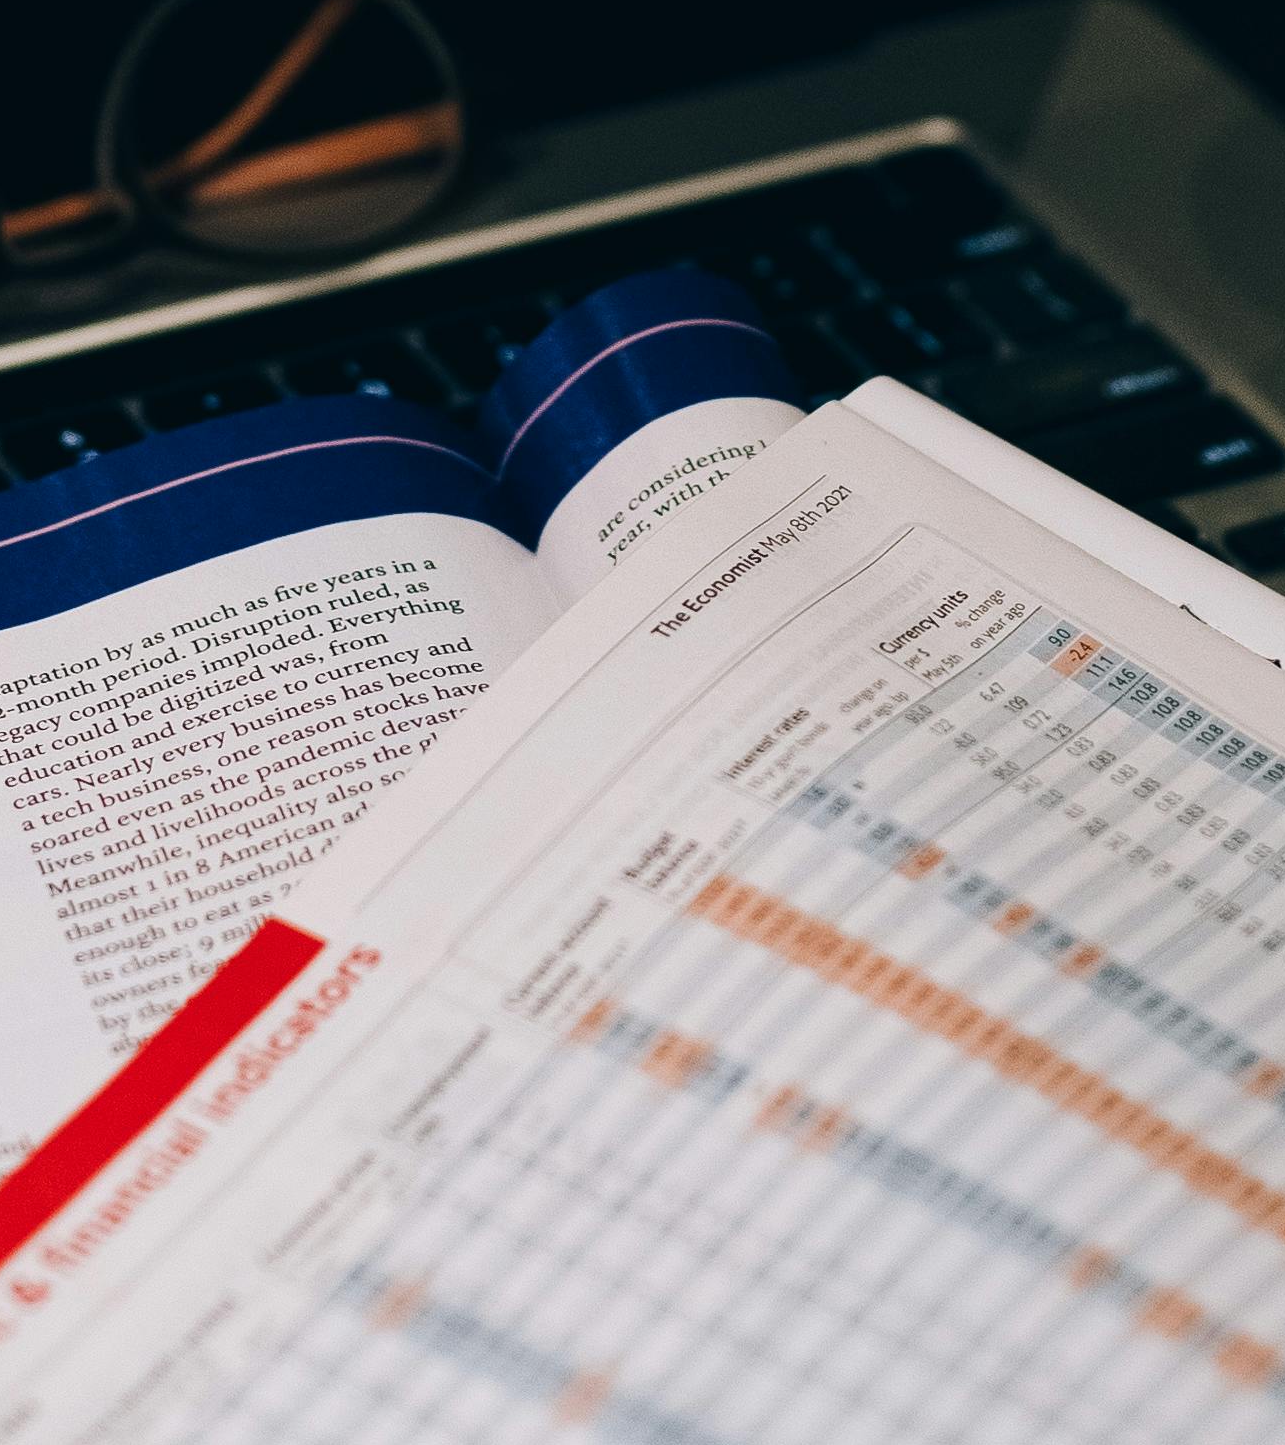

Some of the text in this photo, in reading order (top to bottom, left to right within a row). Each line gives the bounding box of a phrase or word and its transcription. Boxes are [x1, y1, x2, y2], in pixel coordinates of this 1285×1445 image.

[597, 444, 757, 543] are considering
[606, 484, 704, 566] year, with
[650, 484, 853, 638] The Economist May 8th 2021
[102, 647, 188, 692] period.
[191, 601, 323, 654] Disruption
[328, 583, 401, 611] ruled,
[405, 580, 430, 594] as
[104, 641, 134, 662] by
[142, 632, 165, 650] as
[171, 604, 239, 638] much
[244, 595, 269, 612] as
[274, 580, 319, 603] five
[323, 564, 387, 592] years
[392, 560, 417, 575] in
[423, 559, 437, 571] a
[878, 589, 969, 655] Currency units
[968, 588, 1006, 623] change
[969, 602, 1026, 651] on year ago
[1047, 627, 1071, 649] 9.0
[51, 718, 118, 751] could
[122, 709, 155, 728] be
[158, 664, 265, 715] digitized
[270, 651, 324, 675] was,
[328, 633, 389, 658] from
[69, 668, 197, 722] companies
[201, 623, 324, 676] imploded.
[328, 597, 465, 635] Everything
[1070, 640, 1094, 663] -2.4
[1086, 655, 1114, 679] 11.1
[1108, 667, 1138, 692] 14.6
[4, 636, 474, 788] education and exercise to currency and
[1130, 681, 1159, 706] 10.8
[1151, 695, 1181, 720] 10.8
[1173, 709, 1203, 734] 10.8
[13, 661, 485, 810] cars. Nearly every business has become
[21, 682, 490, 832] a tech business, one reason stocks have
[724, 734, 778, 780] Interest
[774, 707, 811, 735] rates
[1195, 723, 1225, 747] 10.8
[1217, 737, 1246, 760] 10.8
[1239, 750, 1268, 773] 10.8
[30, 730, 376, 854] soared even as the pandemic
[35, 850, 95, 876] lives
[102, 829, 147, 857] and
[150, 781, 286, 840] livelihoods
[293, 756, 367, 791] across
[372, 740, 413, 764] the
[46, 779, 374, 898] Meanwhile, inequality also
[56, 883, 139, 920] almost
[164, 869, 189, 888] in
[195, 858, 211, 875] 8
[218, 817, 336, 868] American
[64, 916, 115, 943] that
[121, 892, 180, 925] their
[184, 845, 314, 904] household
[73, 889, 273, 965] enough to eat as
[211, 939, 385, 1120] indicators
